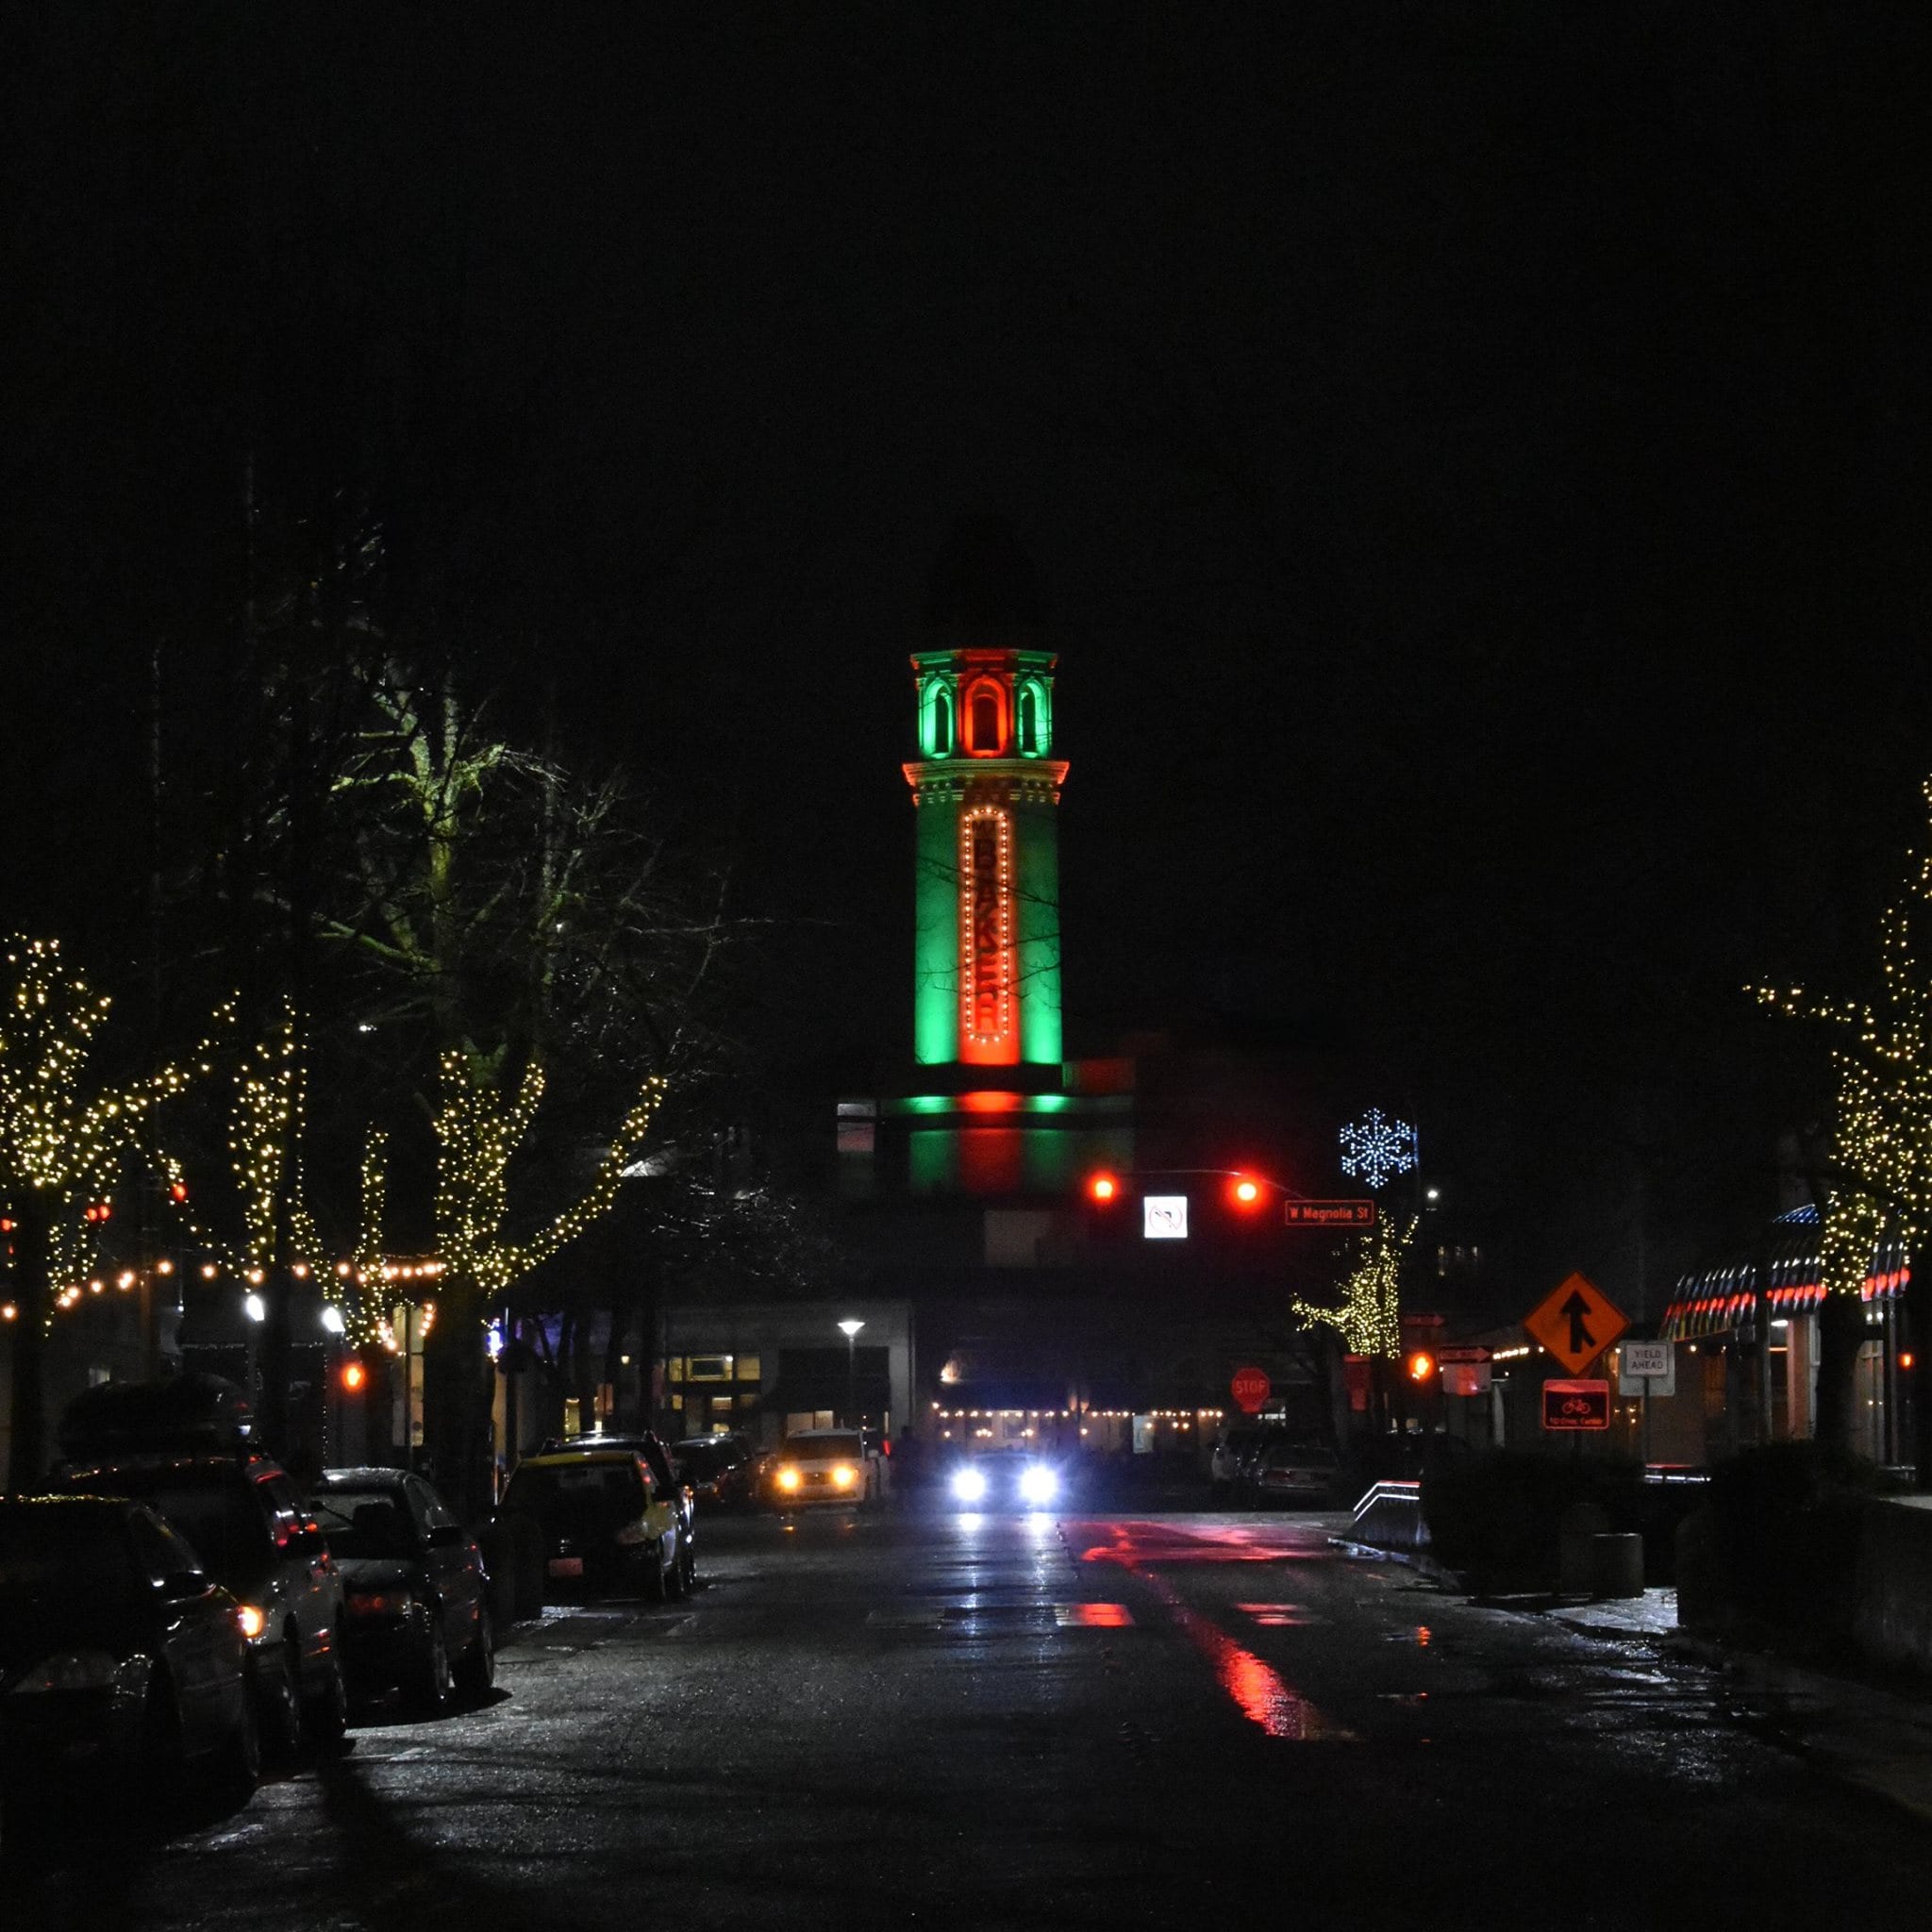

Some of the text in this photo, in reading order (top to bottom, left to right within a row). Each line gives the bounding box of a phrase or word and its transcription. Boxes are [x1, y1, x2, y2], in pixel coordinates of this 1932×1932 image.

[1290, 1208, 1368, 1223] W Magnolia St
[1634, 1350, 1661, 1358] YIELD
[1632, 1360, 1663, 1369] AHEAD
[1236, 1380, 1266, 1394] STOP
